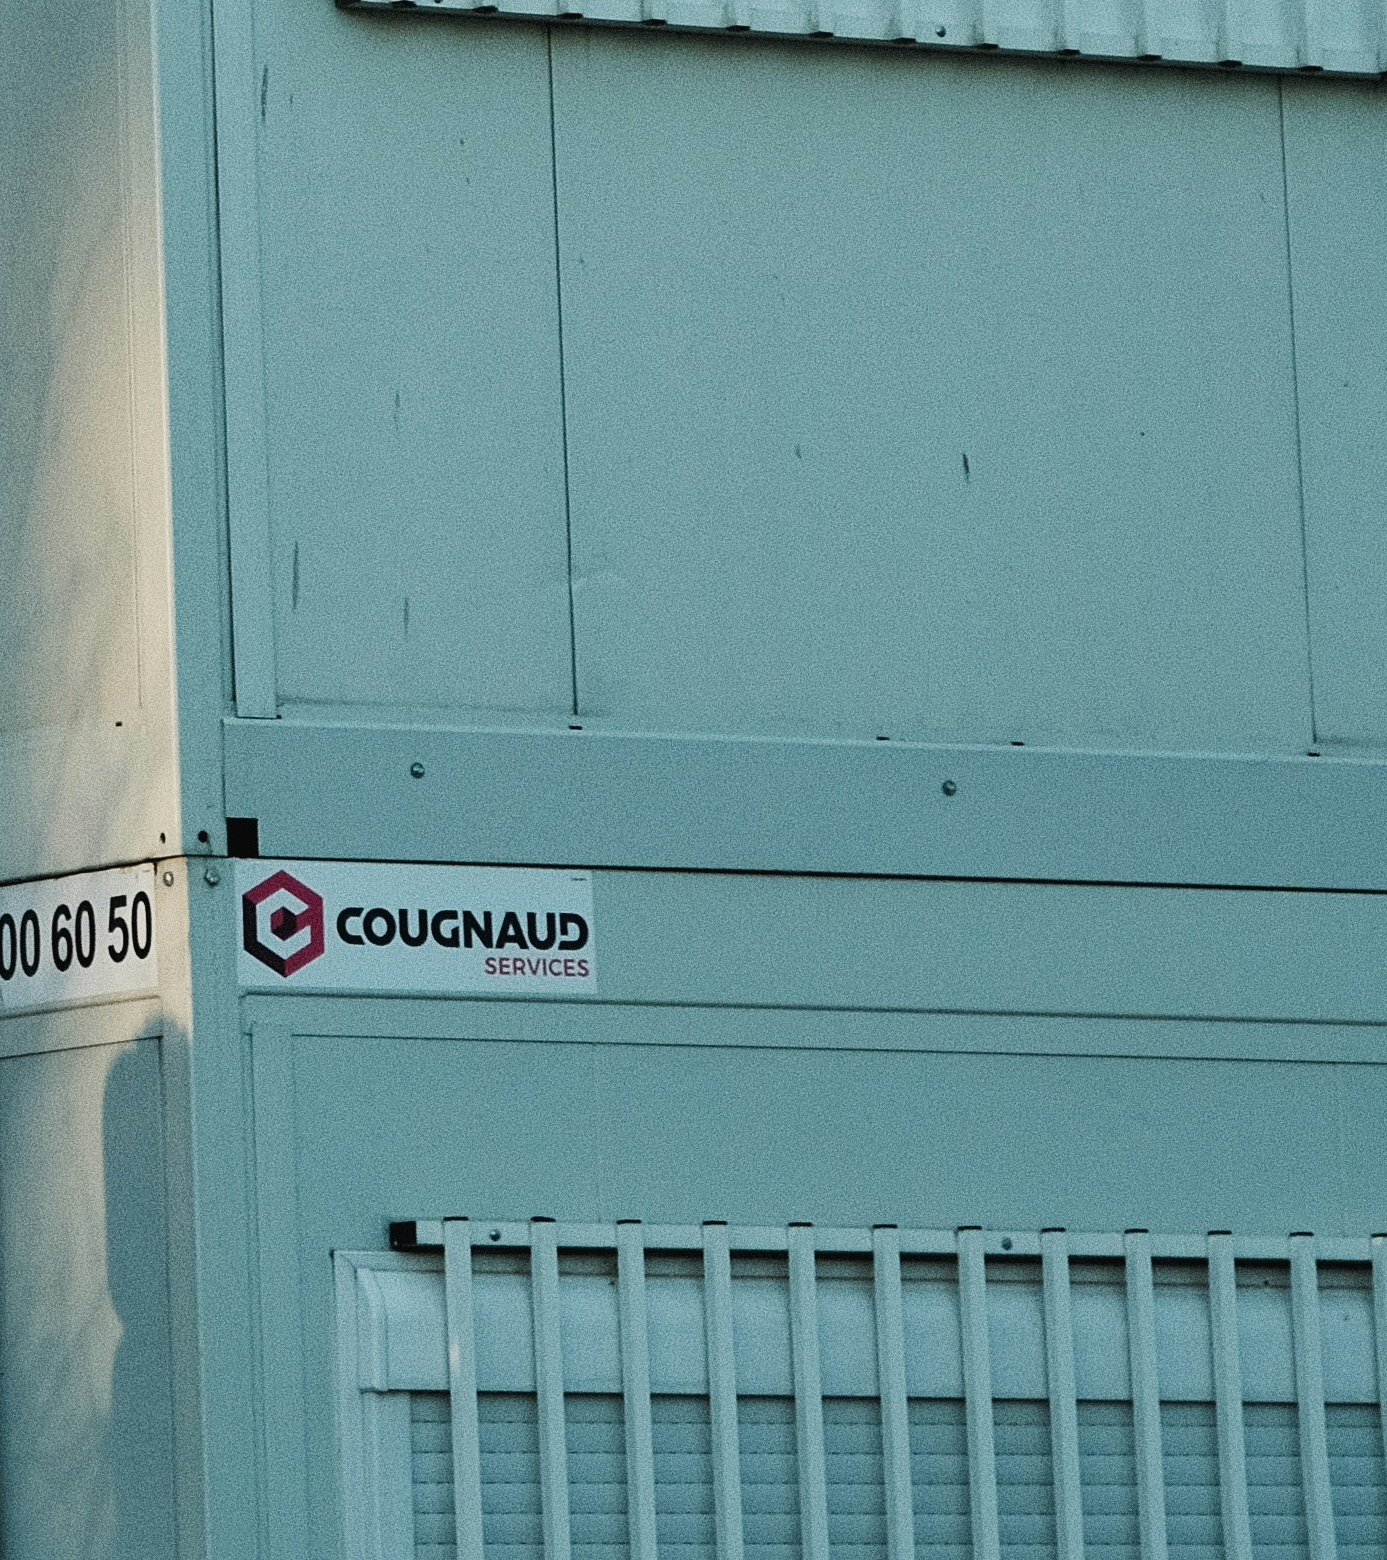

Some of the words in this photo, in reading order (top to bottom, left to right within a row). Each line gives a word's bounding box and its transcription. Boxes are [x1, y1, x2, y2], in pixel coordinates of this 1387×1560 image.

[52, 900, 95, 972] 60
[108, 892, 151, 962] 50
[337, 907, 589, 950] COUGNAUD
[485, 957, 589, 977] SERVICES
